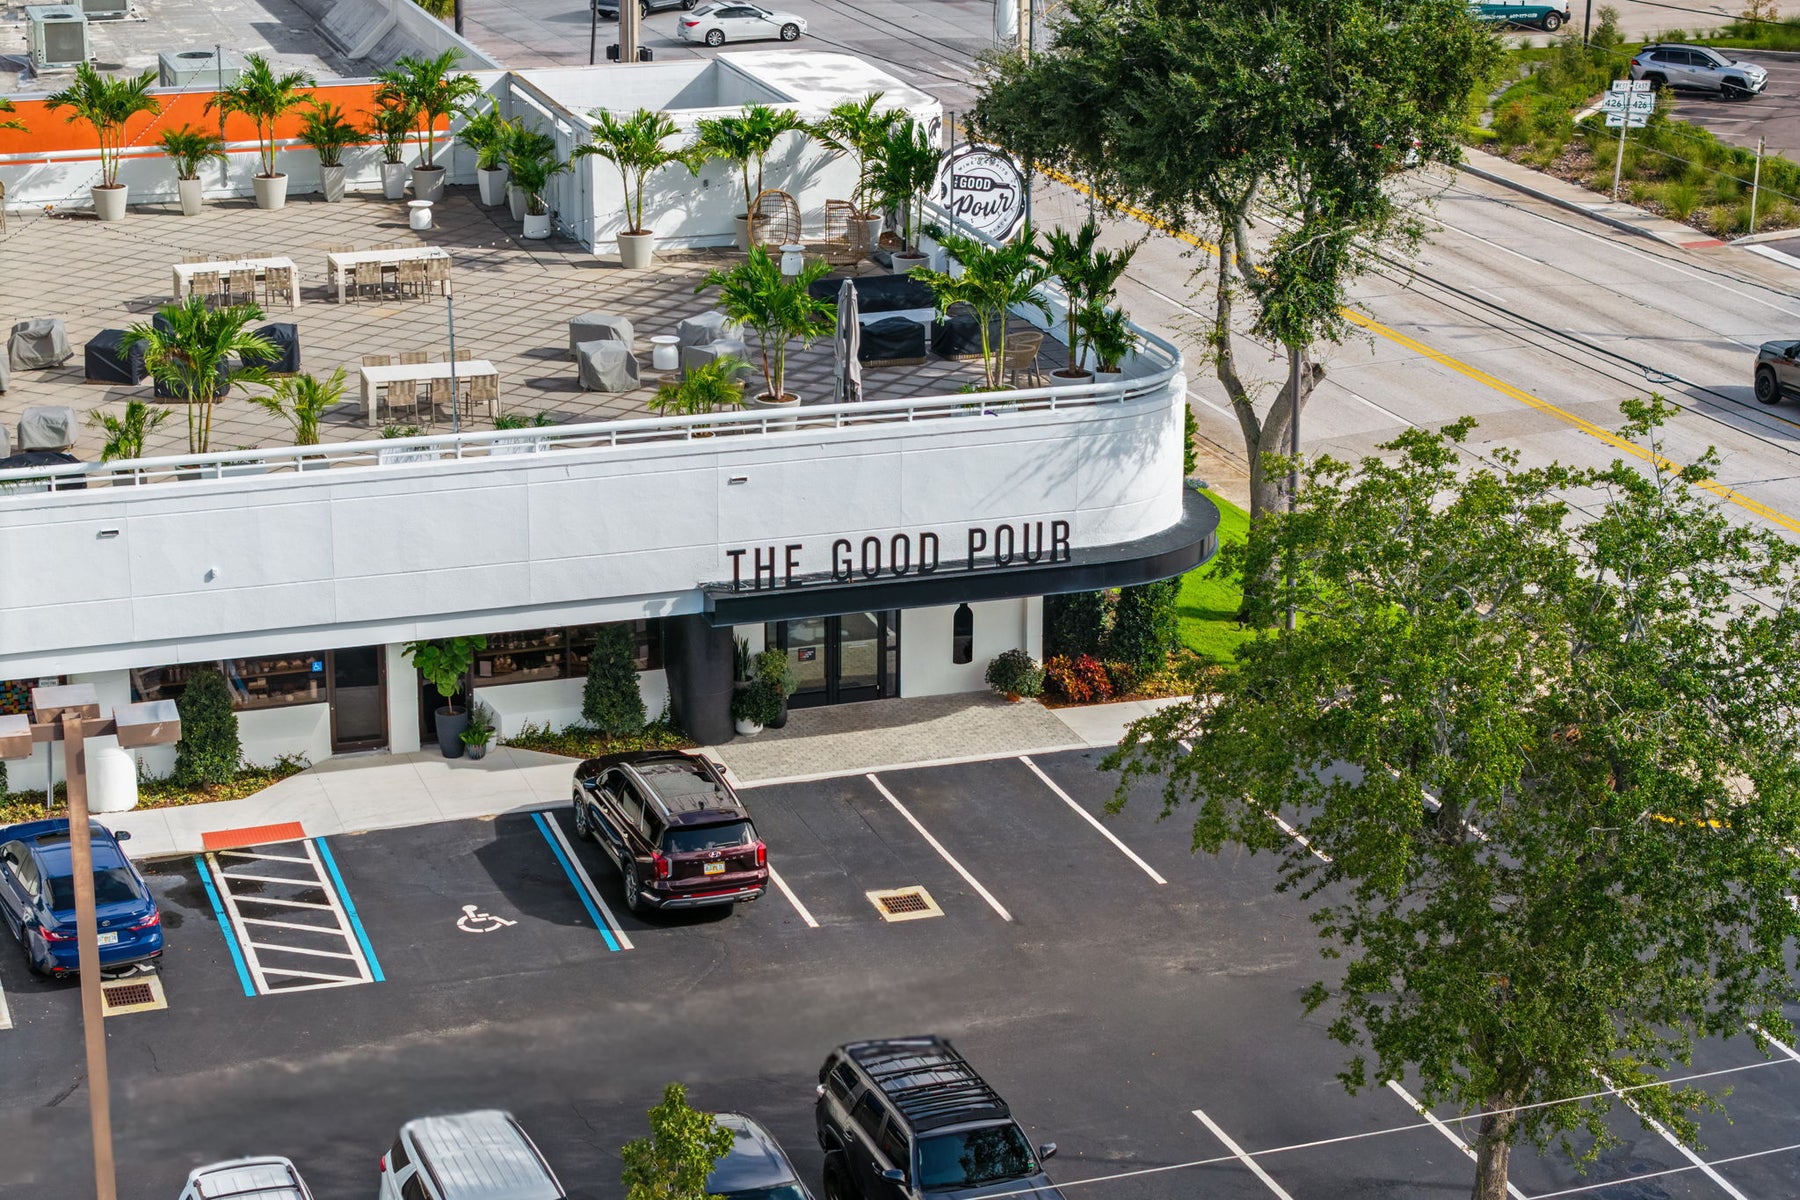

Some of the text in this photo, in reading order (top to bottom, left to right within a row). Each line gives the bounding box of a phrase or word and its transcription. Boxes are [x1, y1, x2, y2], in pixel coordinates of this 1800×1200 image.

[1605, 99, 1622, 108] 426
[1633, 101, 1648, 109] 426
[960, 177, 991, 190] GOOD
[943, 192, 1012, 217] Pour
[726, 520, 1072, 594] THE GOOD POUR
